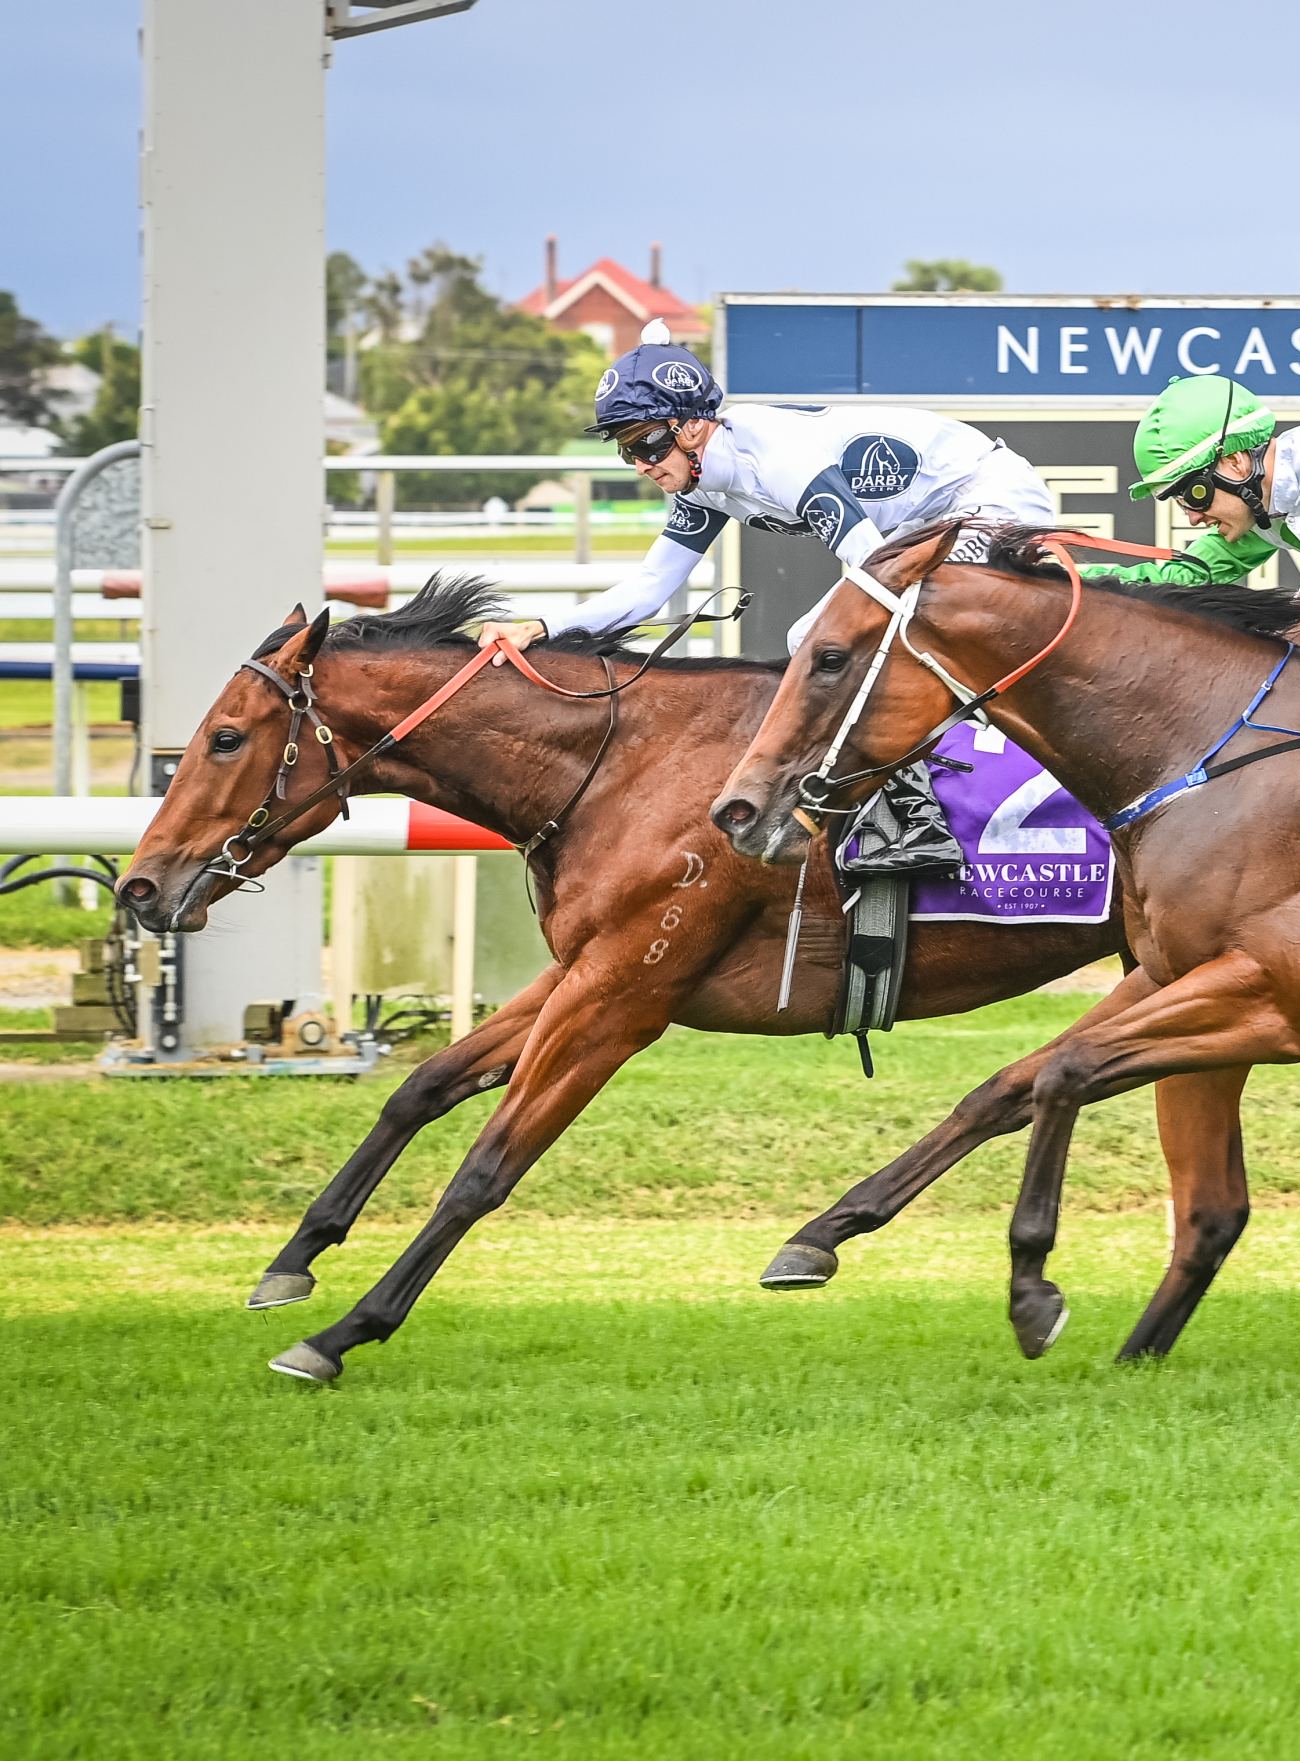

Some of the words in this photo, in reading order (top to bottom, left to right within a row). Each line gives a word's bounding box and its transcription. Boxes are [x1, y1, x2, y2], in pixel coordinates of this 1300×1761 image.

[851, 474, 909, 490] DARBY
[974, 725, 1088, 854] 2
[958, 862, 1106, 883] EWCASTLE
[959, 886, 1085, 899] RACECOURSE
